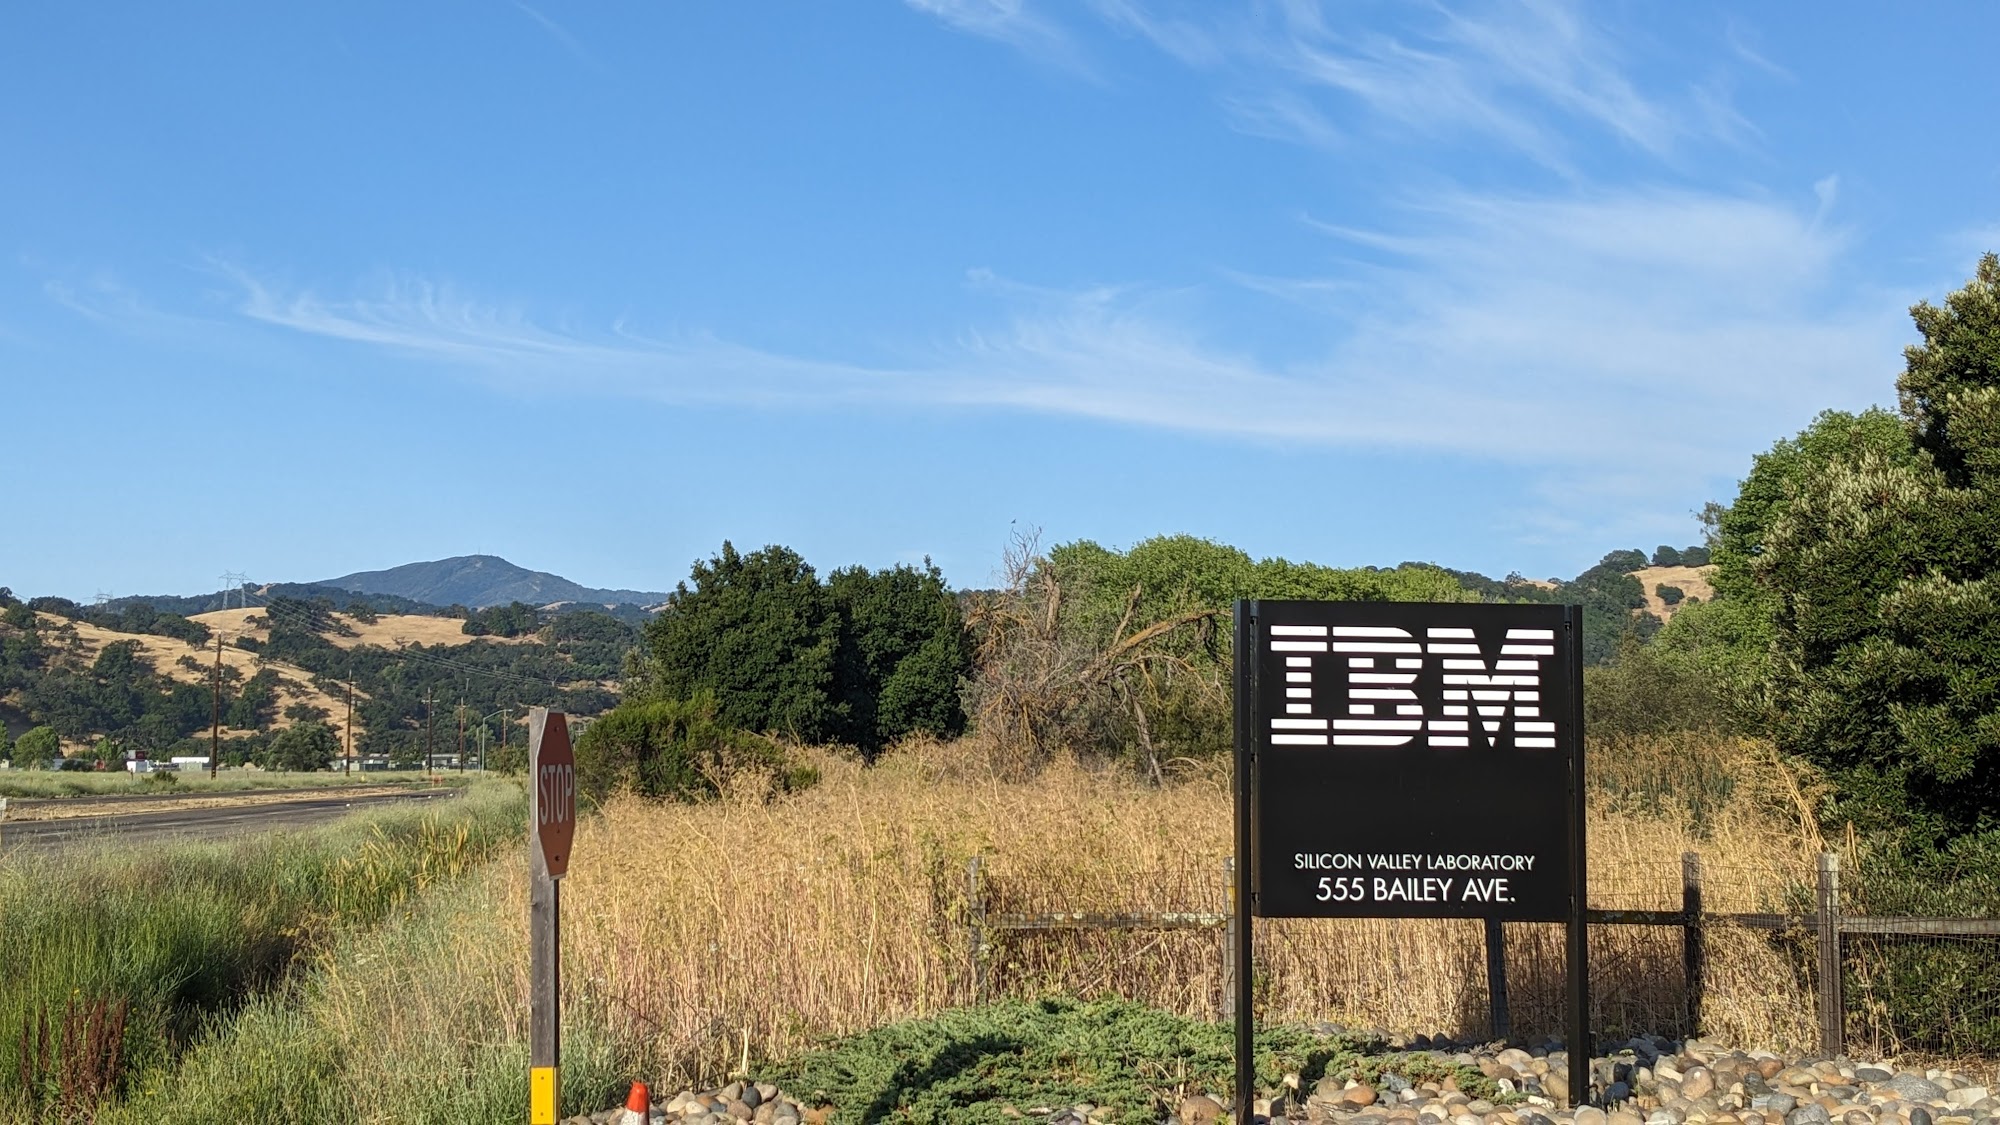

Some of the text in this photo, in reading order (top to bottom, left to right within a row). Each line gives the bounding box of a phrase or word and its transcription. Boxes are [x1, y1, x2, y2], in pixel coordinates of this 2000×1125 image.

[1270, 625, 1556, 748] IBM
[540, 763, 573, 825] STOP
[1294, 853, 1535, 871] SILICON VALLEY LABORATORY
[1315, 876, 1516, 903] 555 BAILEY AVE.
